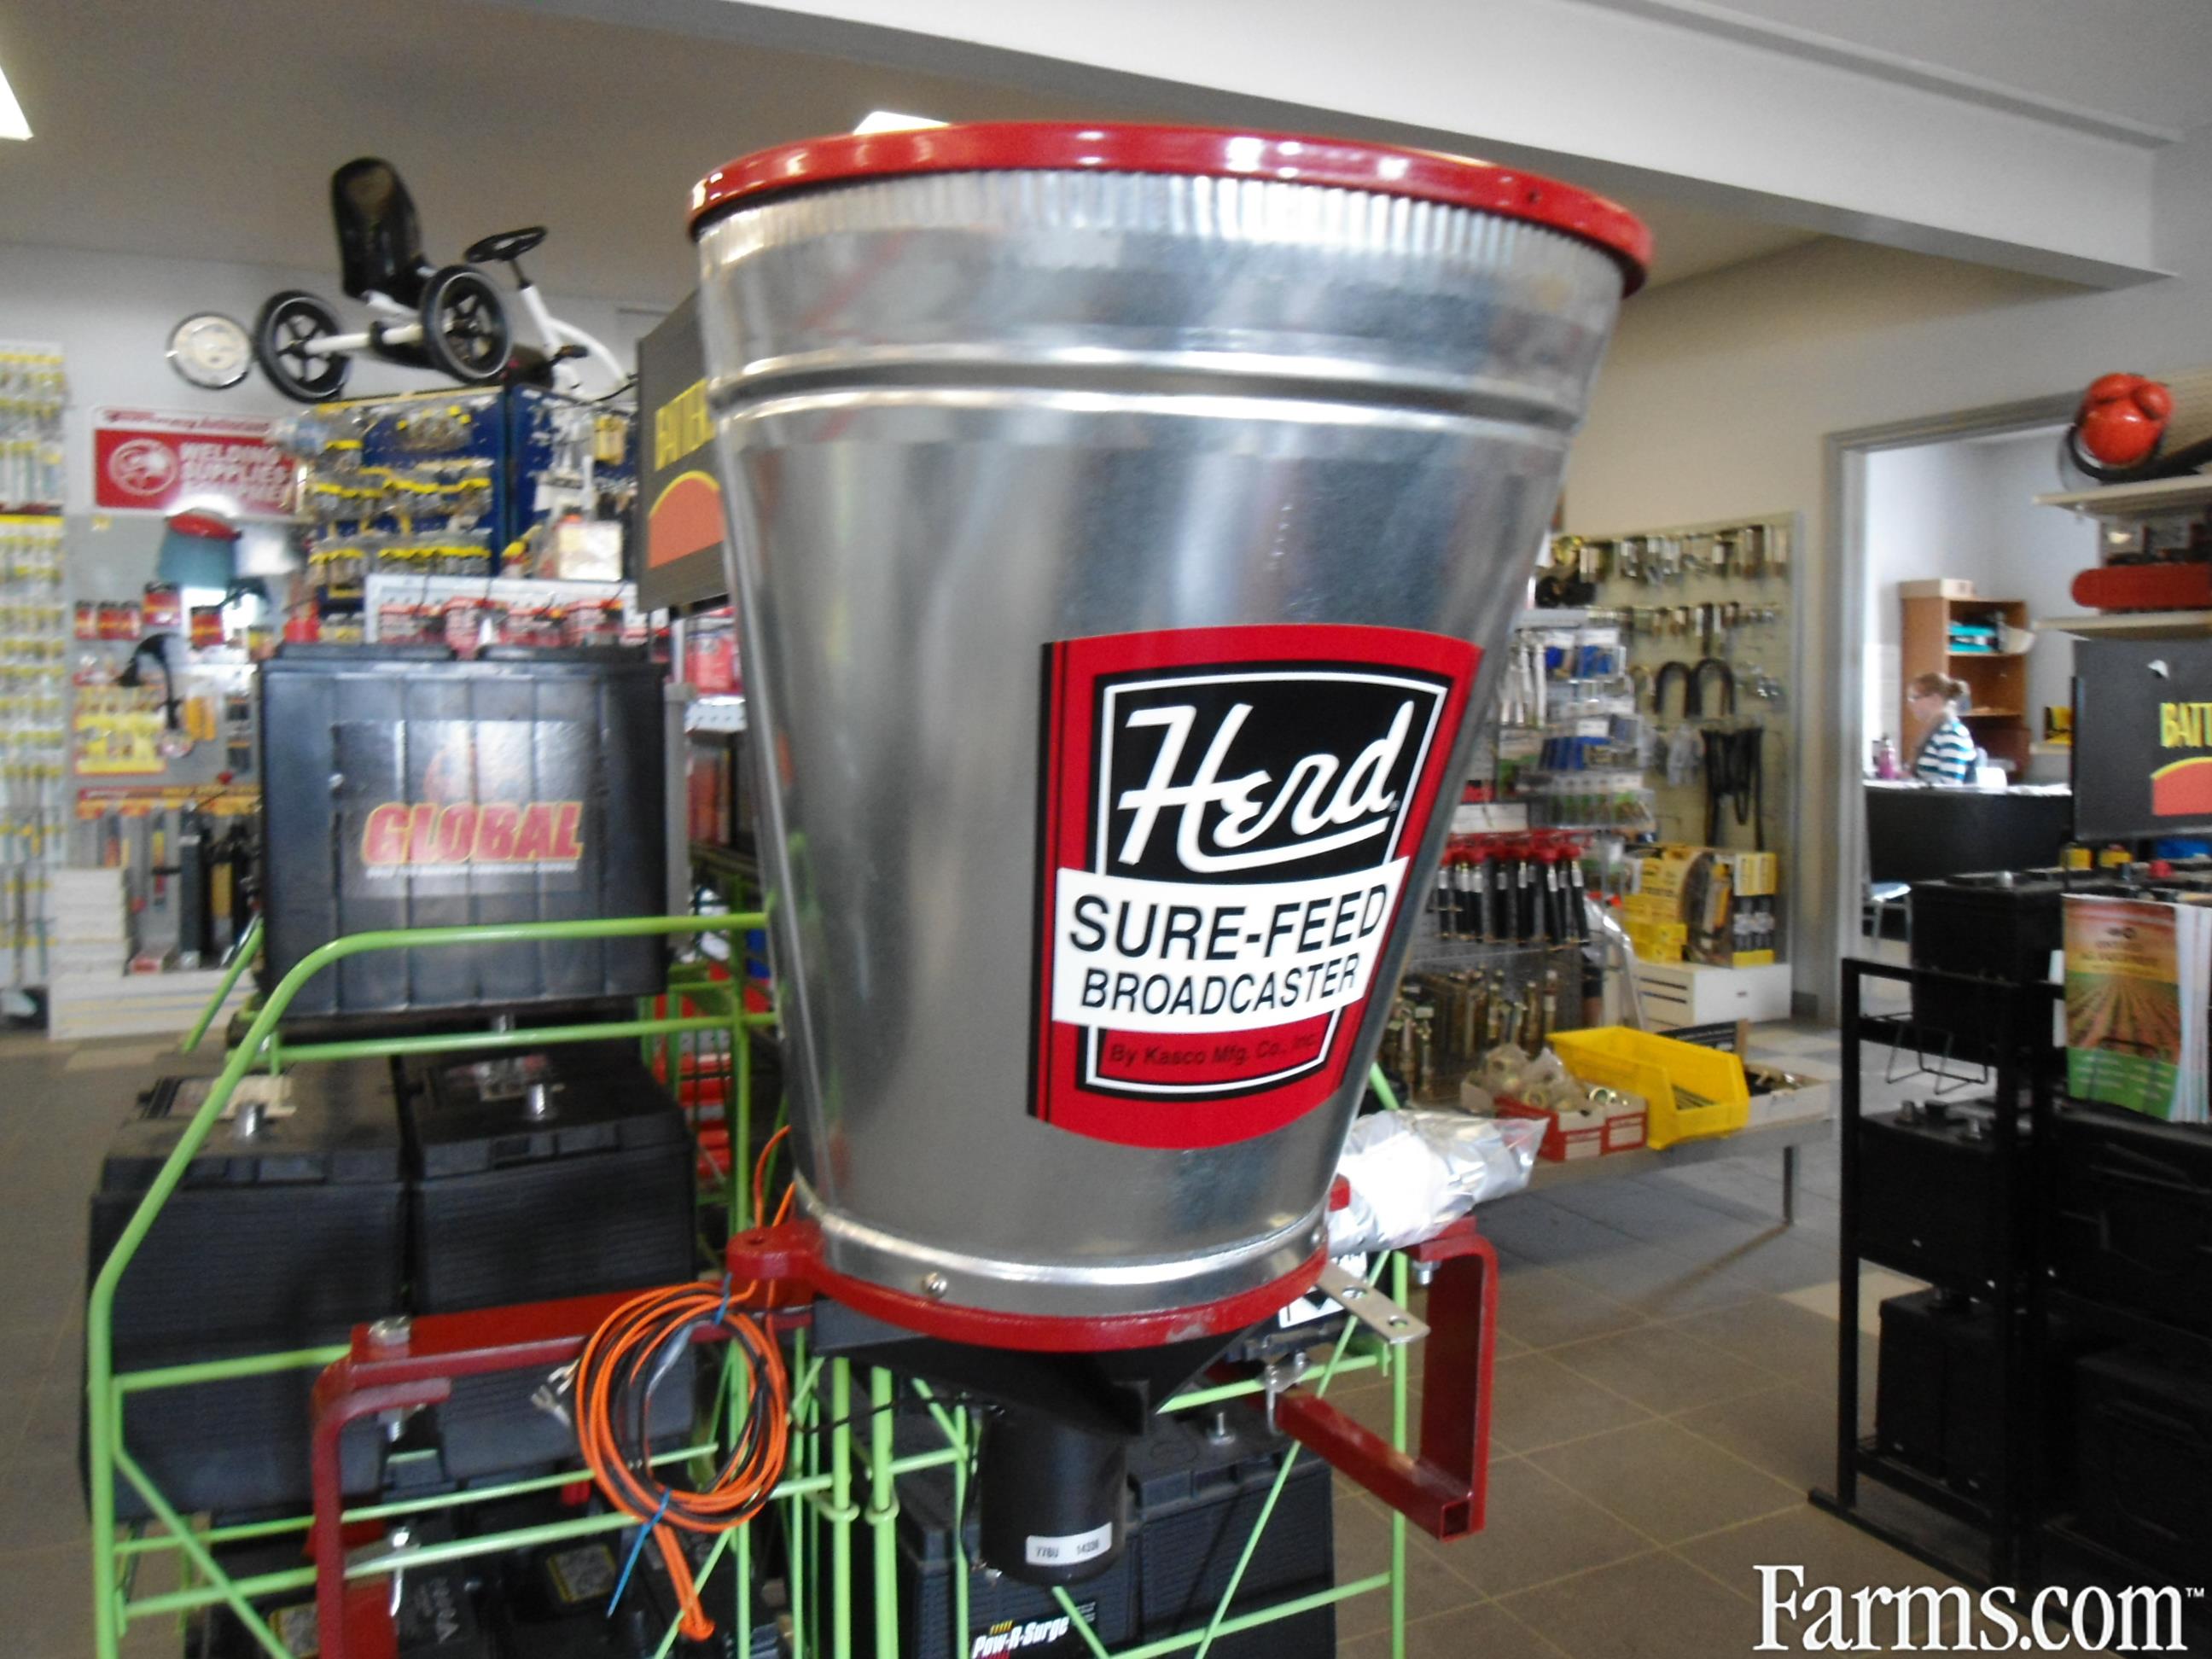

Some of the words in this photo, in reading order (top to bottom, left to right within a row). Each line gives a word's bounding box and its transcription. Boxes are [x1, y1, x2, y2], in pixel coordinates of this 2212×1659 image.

[1118, 700, 1416, 873] Herd
[361, 801, 585, 865] GLOBAL
[1069, 882, 1389, 962] SURE-FEED
[1080, 952, 1360, 1016] BROADCASTER
[1110, 1043, 1138, 1067] By
[1143, 1046, 1206, 1065] Kasco
[971, 1615, 1070, 1659] Pow-R-Surge
